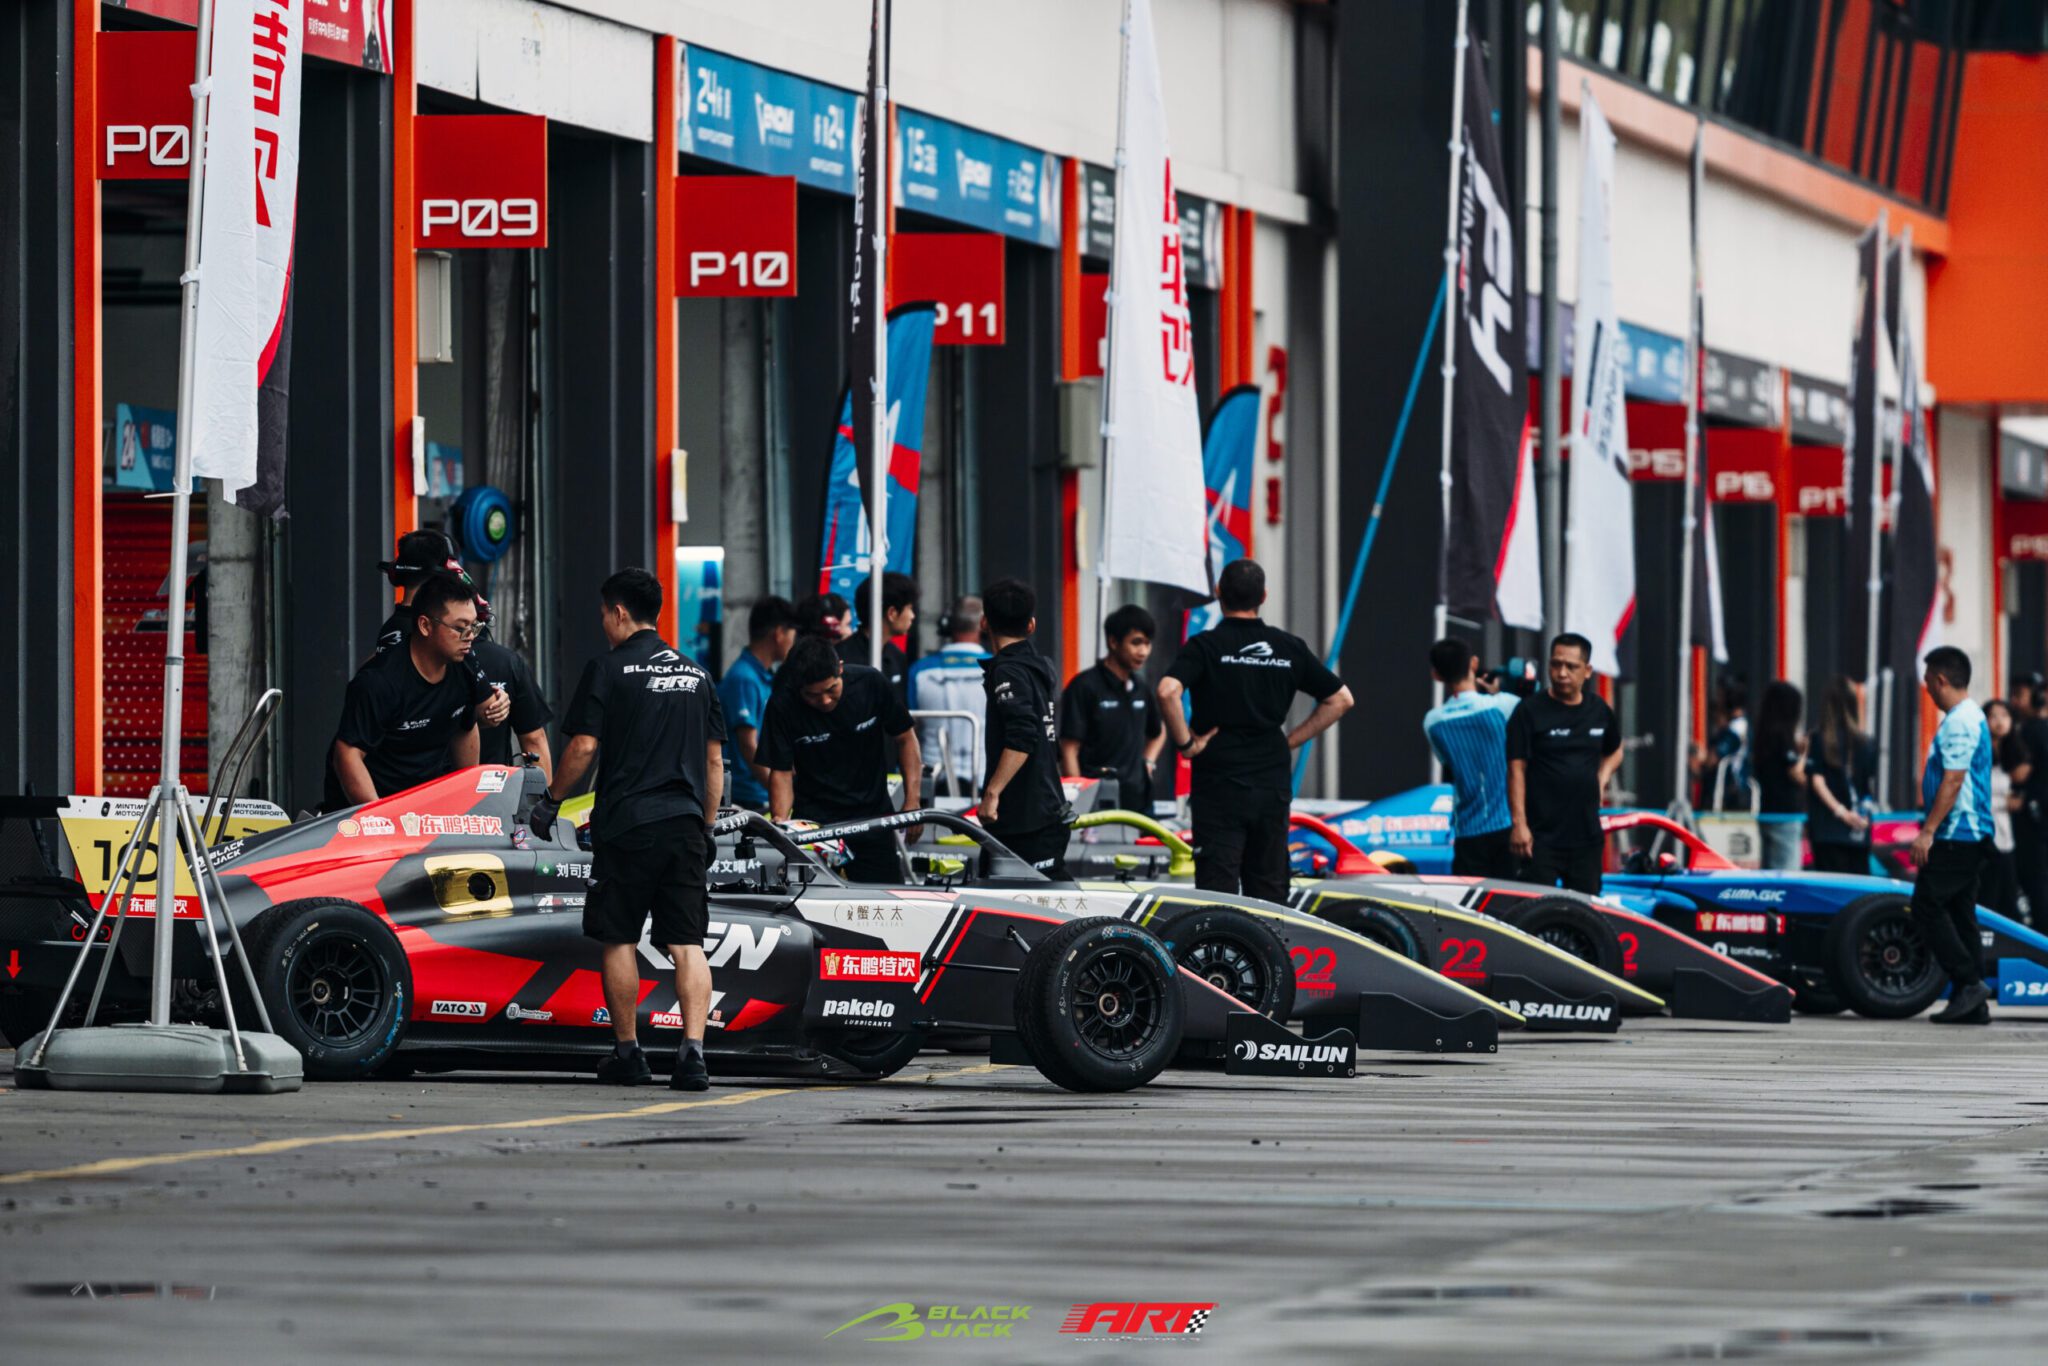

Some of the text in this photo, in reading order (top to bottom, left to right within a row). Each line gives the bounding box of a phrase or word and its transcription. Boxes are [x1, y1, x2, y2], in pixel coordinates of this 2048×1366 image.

[107, 125, 206, 166] P0
[422, 198, 539, 237] P09
[690, 250, 789, 288] P10
[623, 664, 706, 679] BLACK JACK
[232, 809, 284, 817] MOTORSPORT
[842, 954, 915, 977] 东鹏特饮
[435, 1003, 467, 1013] YATO
[822, 998, 895, 1017] pakelo
[1522, 1001, 1611, 1021] SAILUN
[651, 1013, 684, 1026] MOTU
[844, 1019, 892, 1027] LUBRICANTS
[1258, 1043, 1349, 1063] SAILUN
